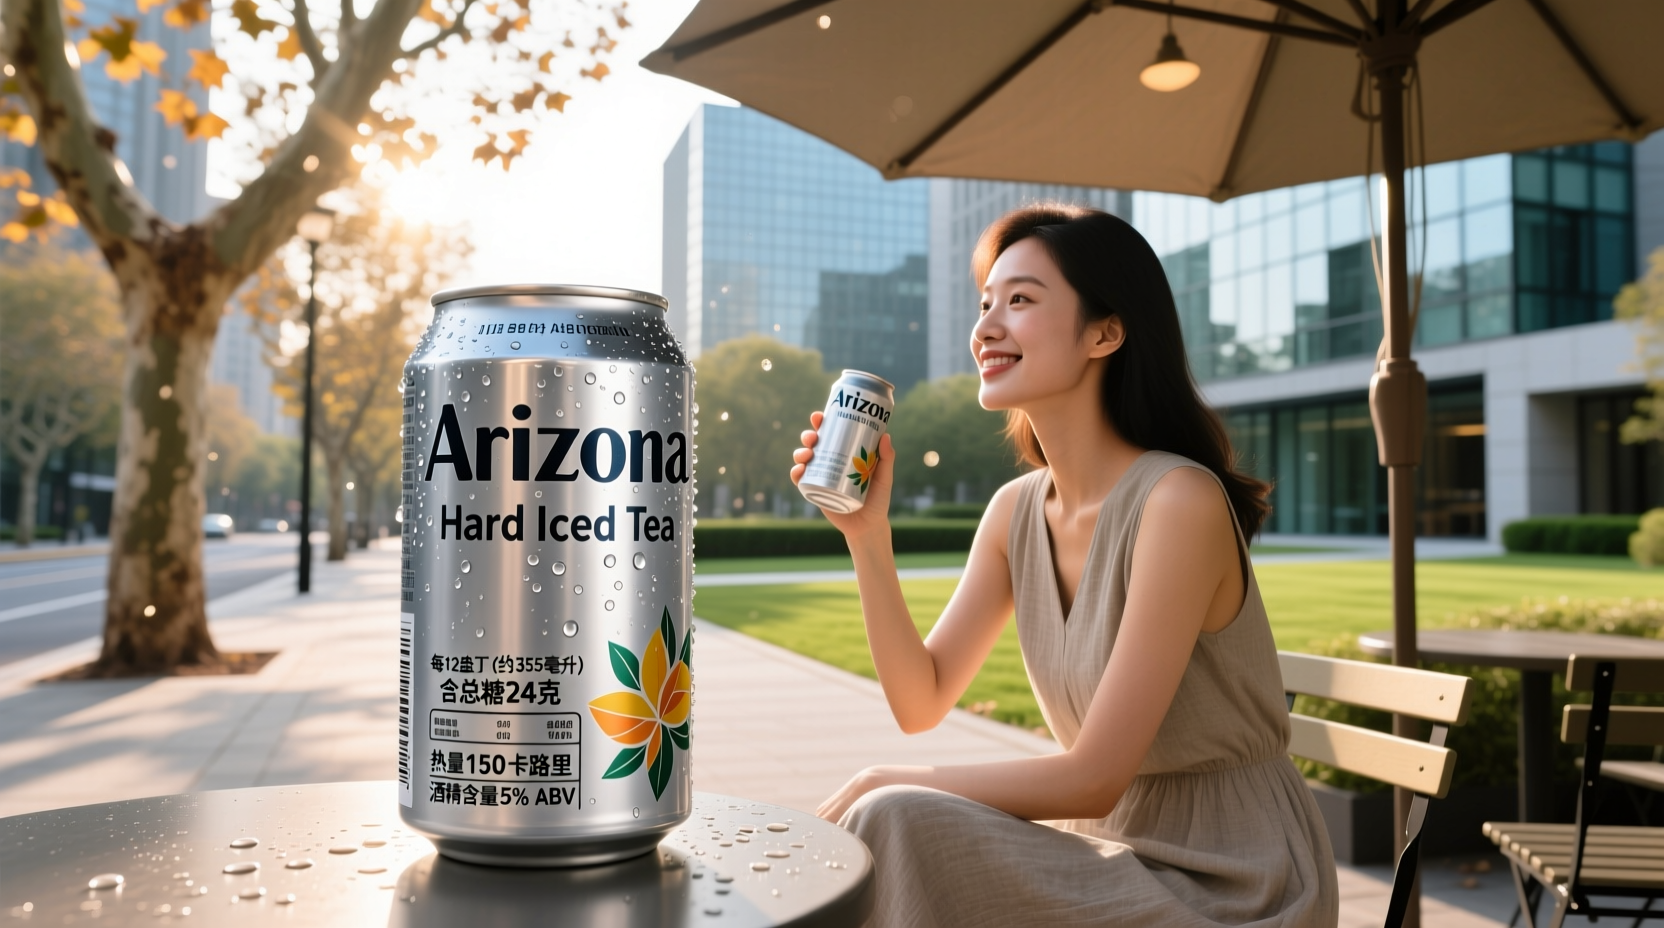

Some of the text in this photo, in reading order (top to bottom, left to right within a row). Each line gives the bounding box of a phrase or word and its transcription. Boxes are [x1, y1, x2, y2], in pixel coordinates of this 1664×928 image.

[425, 403, 689, 484] Arizona
[441, 504, 675, 542] Hard Iced Tea
[440, 678, 561, 706] 含总糖24克
[535, 787, 576, 806] ABV
